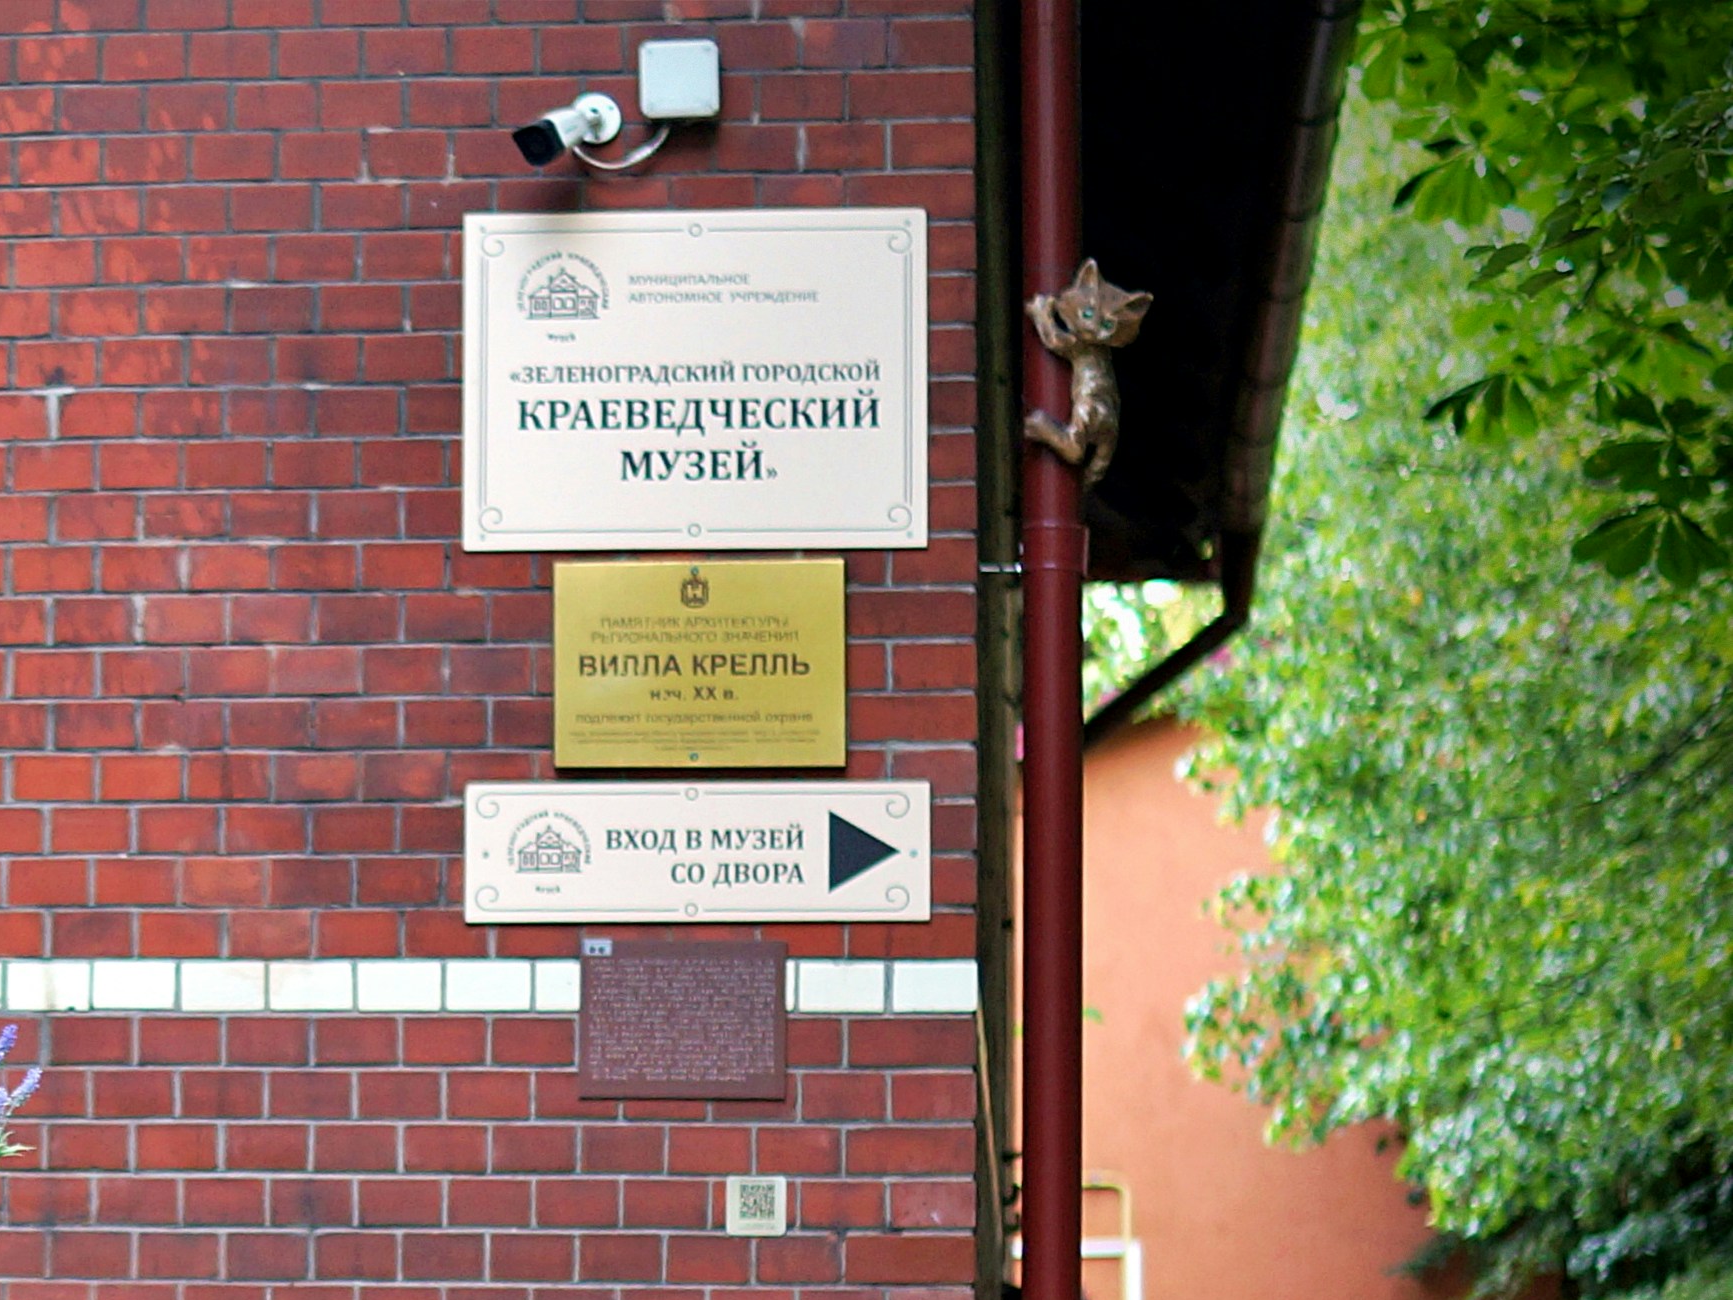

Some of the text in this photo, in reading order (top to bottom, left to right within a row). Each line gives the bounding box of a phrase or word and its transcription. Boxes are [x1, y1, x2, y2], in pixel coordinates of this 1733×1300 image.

[627, 273, 751, 287] МУНИЦИПАЛЬНОЕ
[627, 290, 820, 304] АВТОНОМНОЕ УЧРЕЖДЕНИЕ
[509, 359, 882, 387] «ЗЕЛЕНОГРАДСКИЙ ГОРОДСКОЙ
[517, 388, 881, 437] КРАЕВЕДЧЕСКИЙ
[619, 440, 778, 482] МУЗЕЙ»
[578, 652, 811, 677] ВИЛЛА КРЕЛЛЬ
[605, 828, 678, 855] ВХОД
[685, 828, 703, 850] В
[710, 823, 805, 850] МУЗЕЙ
[670, 861, 806, 888] СО ДВОРА
